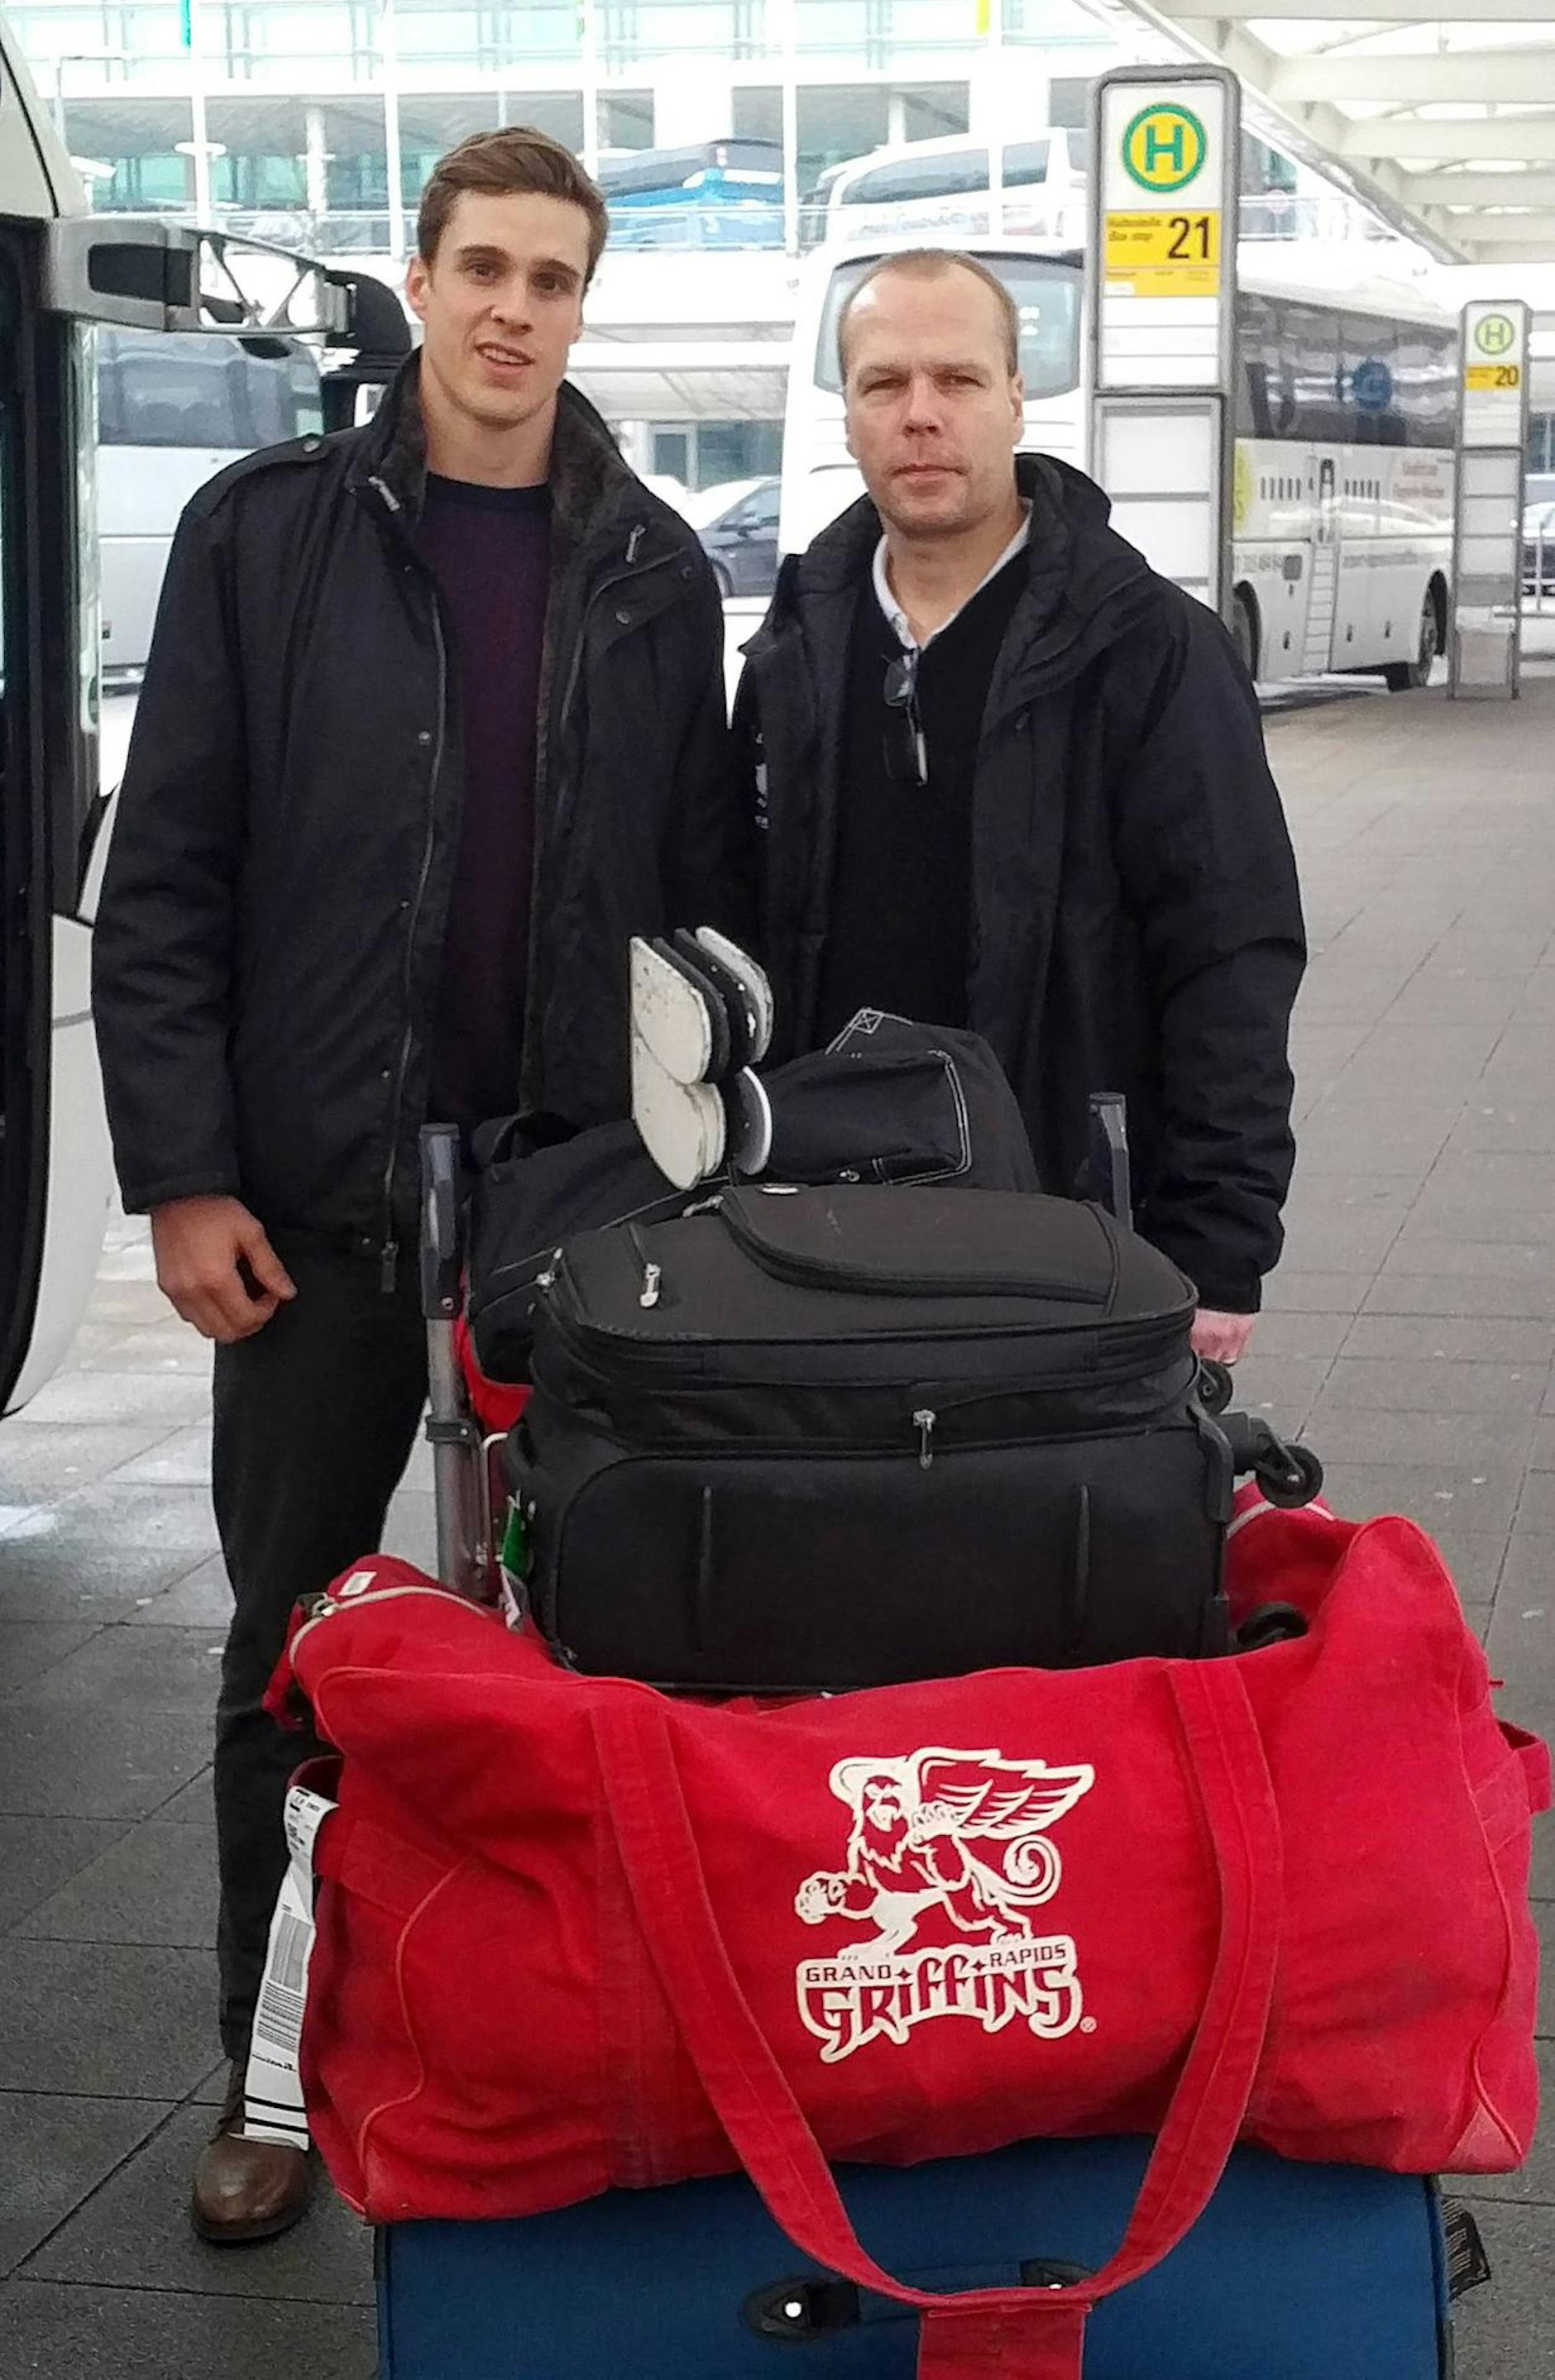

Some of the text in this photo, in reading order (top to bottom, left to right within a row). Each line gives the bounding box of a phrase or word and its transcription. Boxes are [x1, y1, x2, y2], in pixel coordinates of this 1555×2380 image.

[1145, 125, 1184, 171] H
[1168, 217, 1209, 259] 21
[1486, 323, 1504, 346] H
[1495, 366, 1519, 387] 20
[805, 1943, 1066, 1982] GRAND RAPIDS
